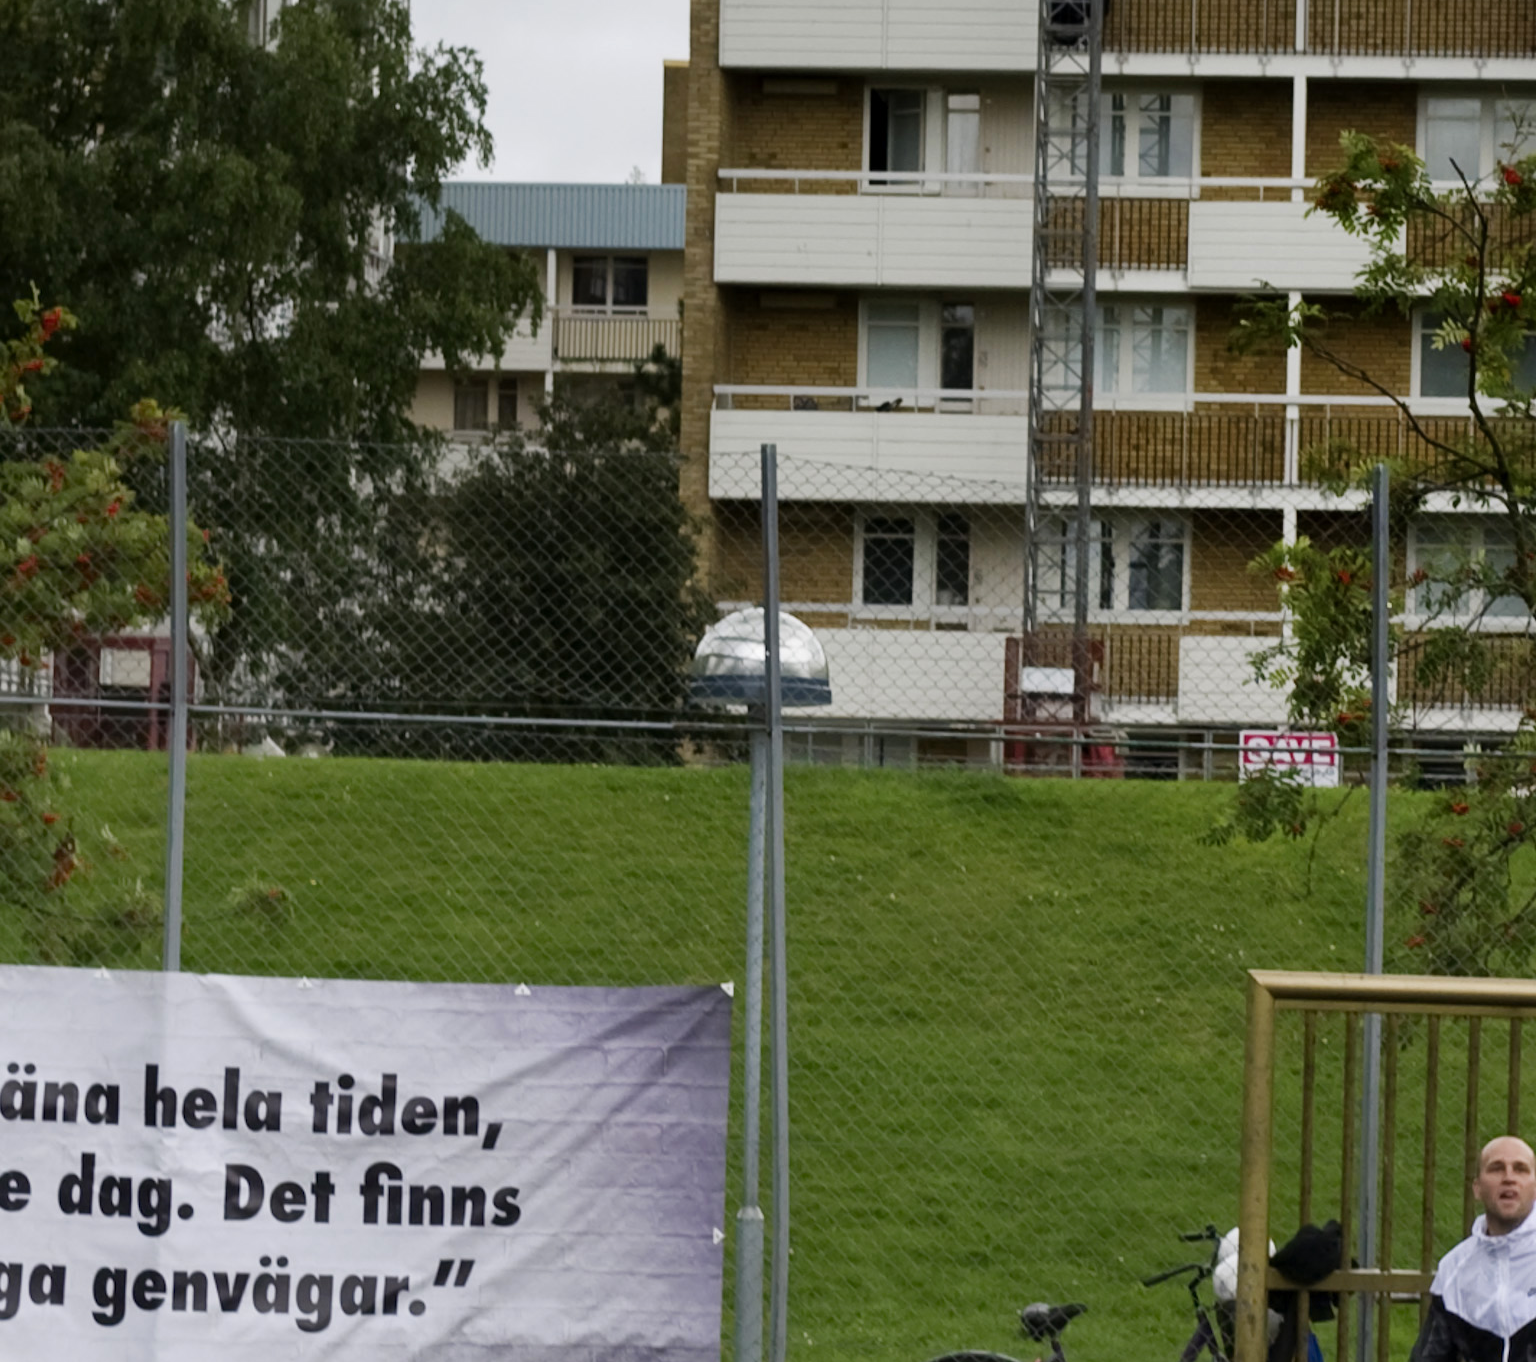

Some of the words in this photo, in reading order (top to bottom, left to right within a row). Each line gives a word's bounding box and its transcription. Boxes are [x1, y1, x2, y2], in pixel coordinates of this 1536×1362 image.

[1247, 737, 1332, 764] SAVE
[144, 1063, 283, 1133] hela
[310, 1073, 503, 1151] tiden,
[57, 1152, 195, 1238] dag.
[223, 1164, 337, 1224] Det
[359, 1161, 522, 1228] finns
[92, 1256, 476, 1334] genvägar.”
